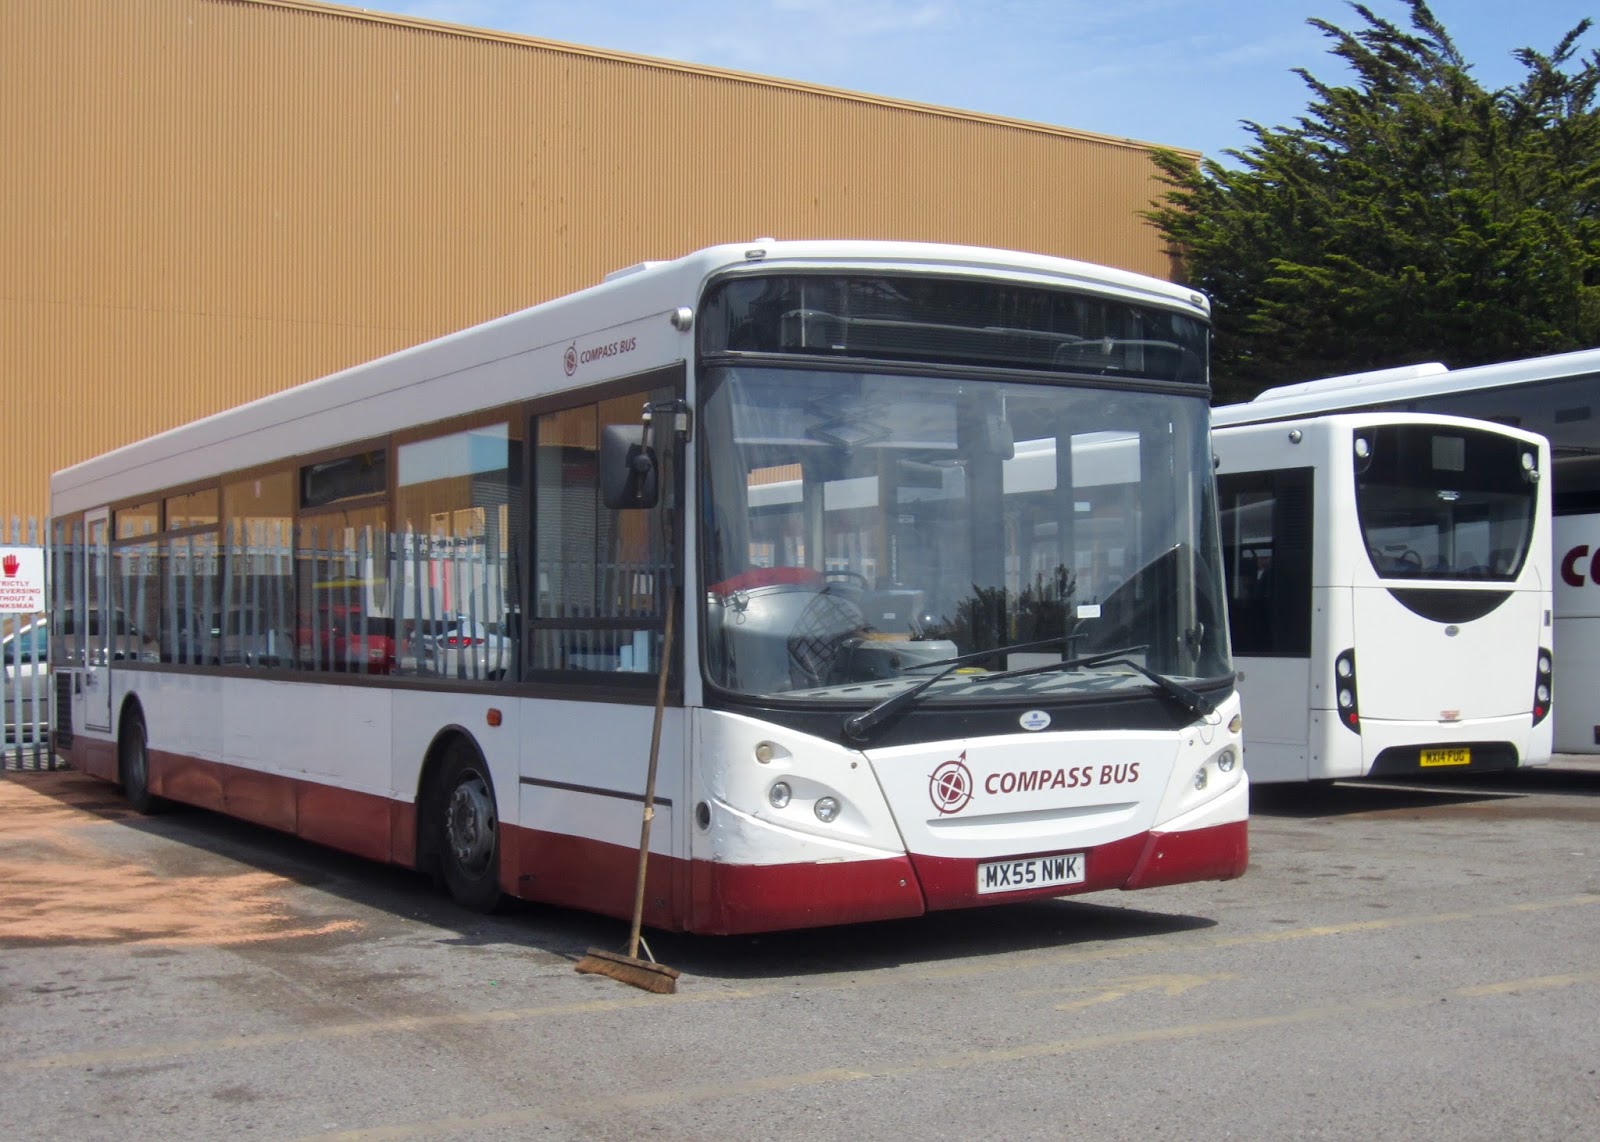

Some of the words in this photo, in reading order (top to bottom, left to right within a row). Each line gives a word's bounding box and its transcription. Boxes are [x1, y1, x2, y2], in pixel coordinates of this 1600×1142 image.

[580, 342, 618, 364] COMPASS
[619, 337, 637, 353] BUS
[984, 766, 1094, 795] COMPASS
[1099, 762, 1140, 785] BUS
[986, 861, 1037, 888] MX55
[1042, 856, 1078, 882] NWK
